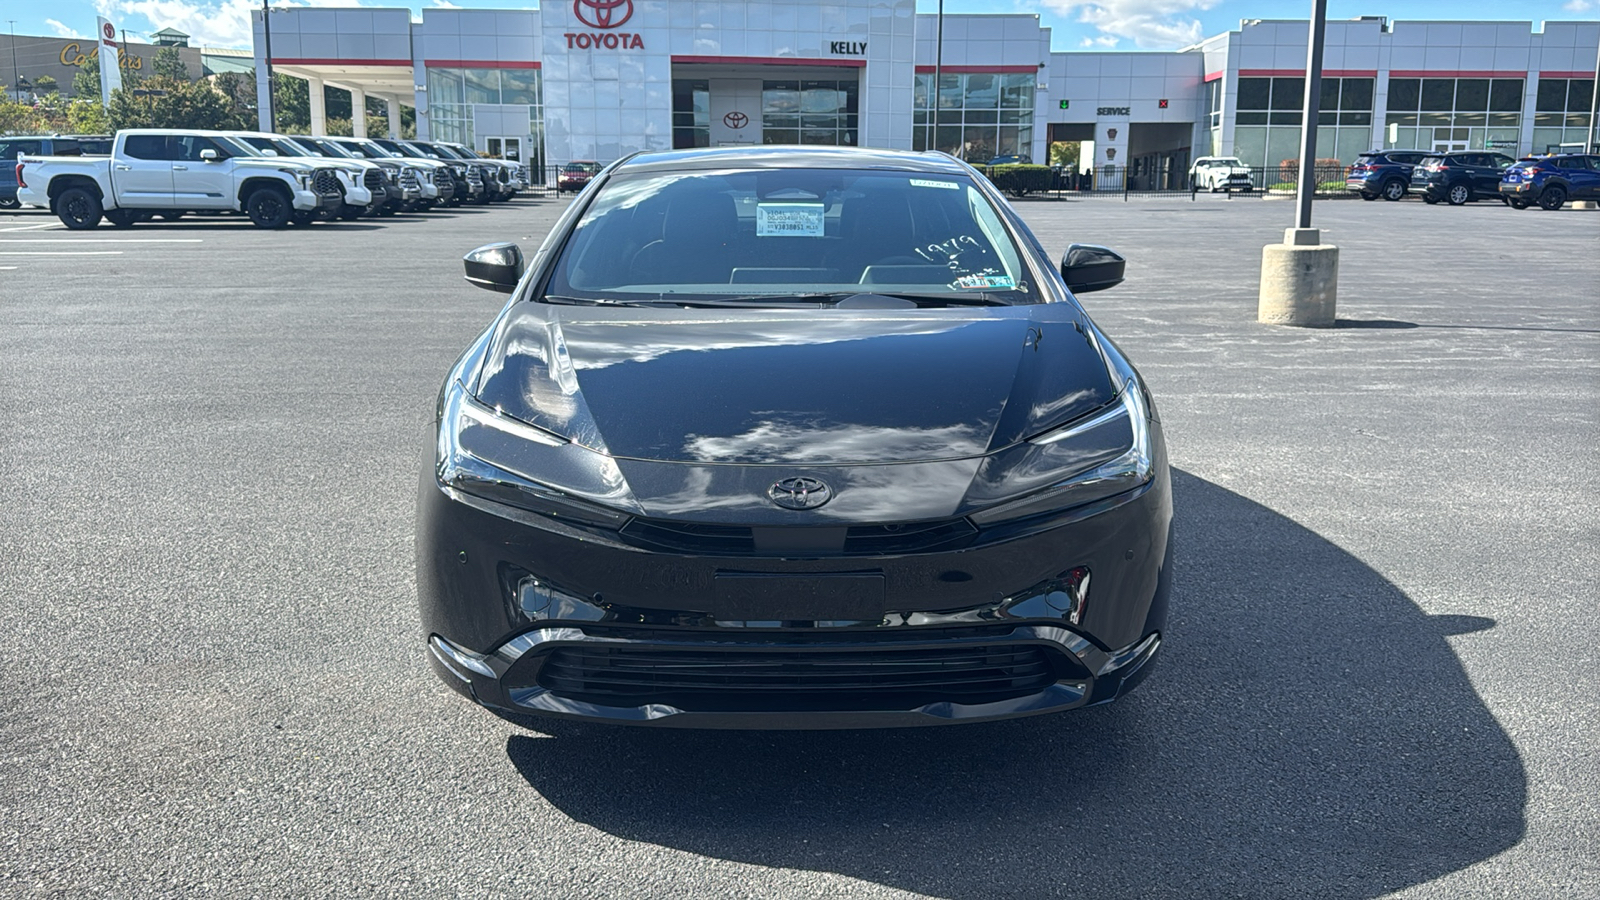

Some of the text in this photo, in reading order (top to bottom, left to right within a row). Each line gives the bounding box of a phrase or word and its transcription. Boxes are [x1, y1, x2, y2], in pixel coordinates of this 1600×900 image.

[564, 32, 644, 50] TOYOTA
[830, 40, 868, 55] KELLY
[1096, 106, 1131, 116] SERVICE
